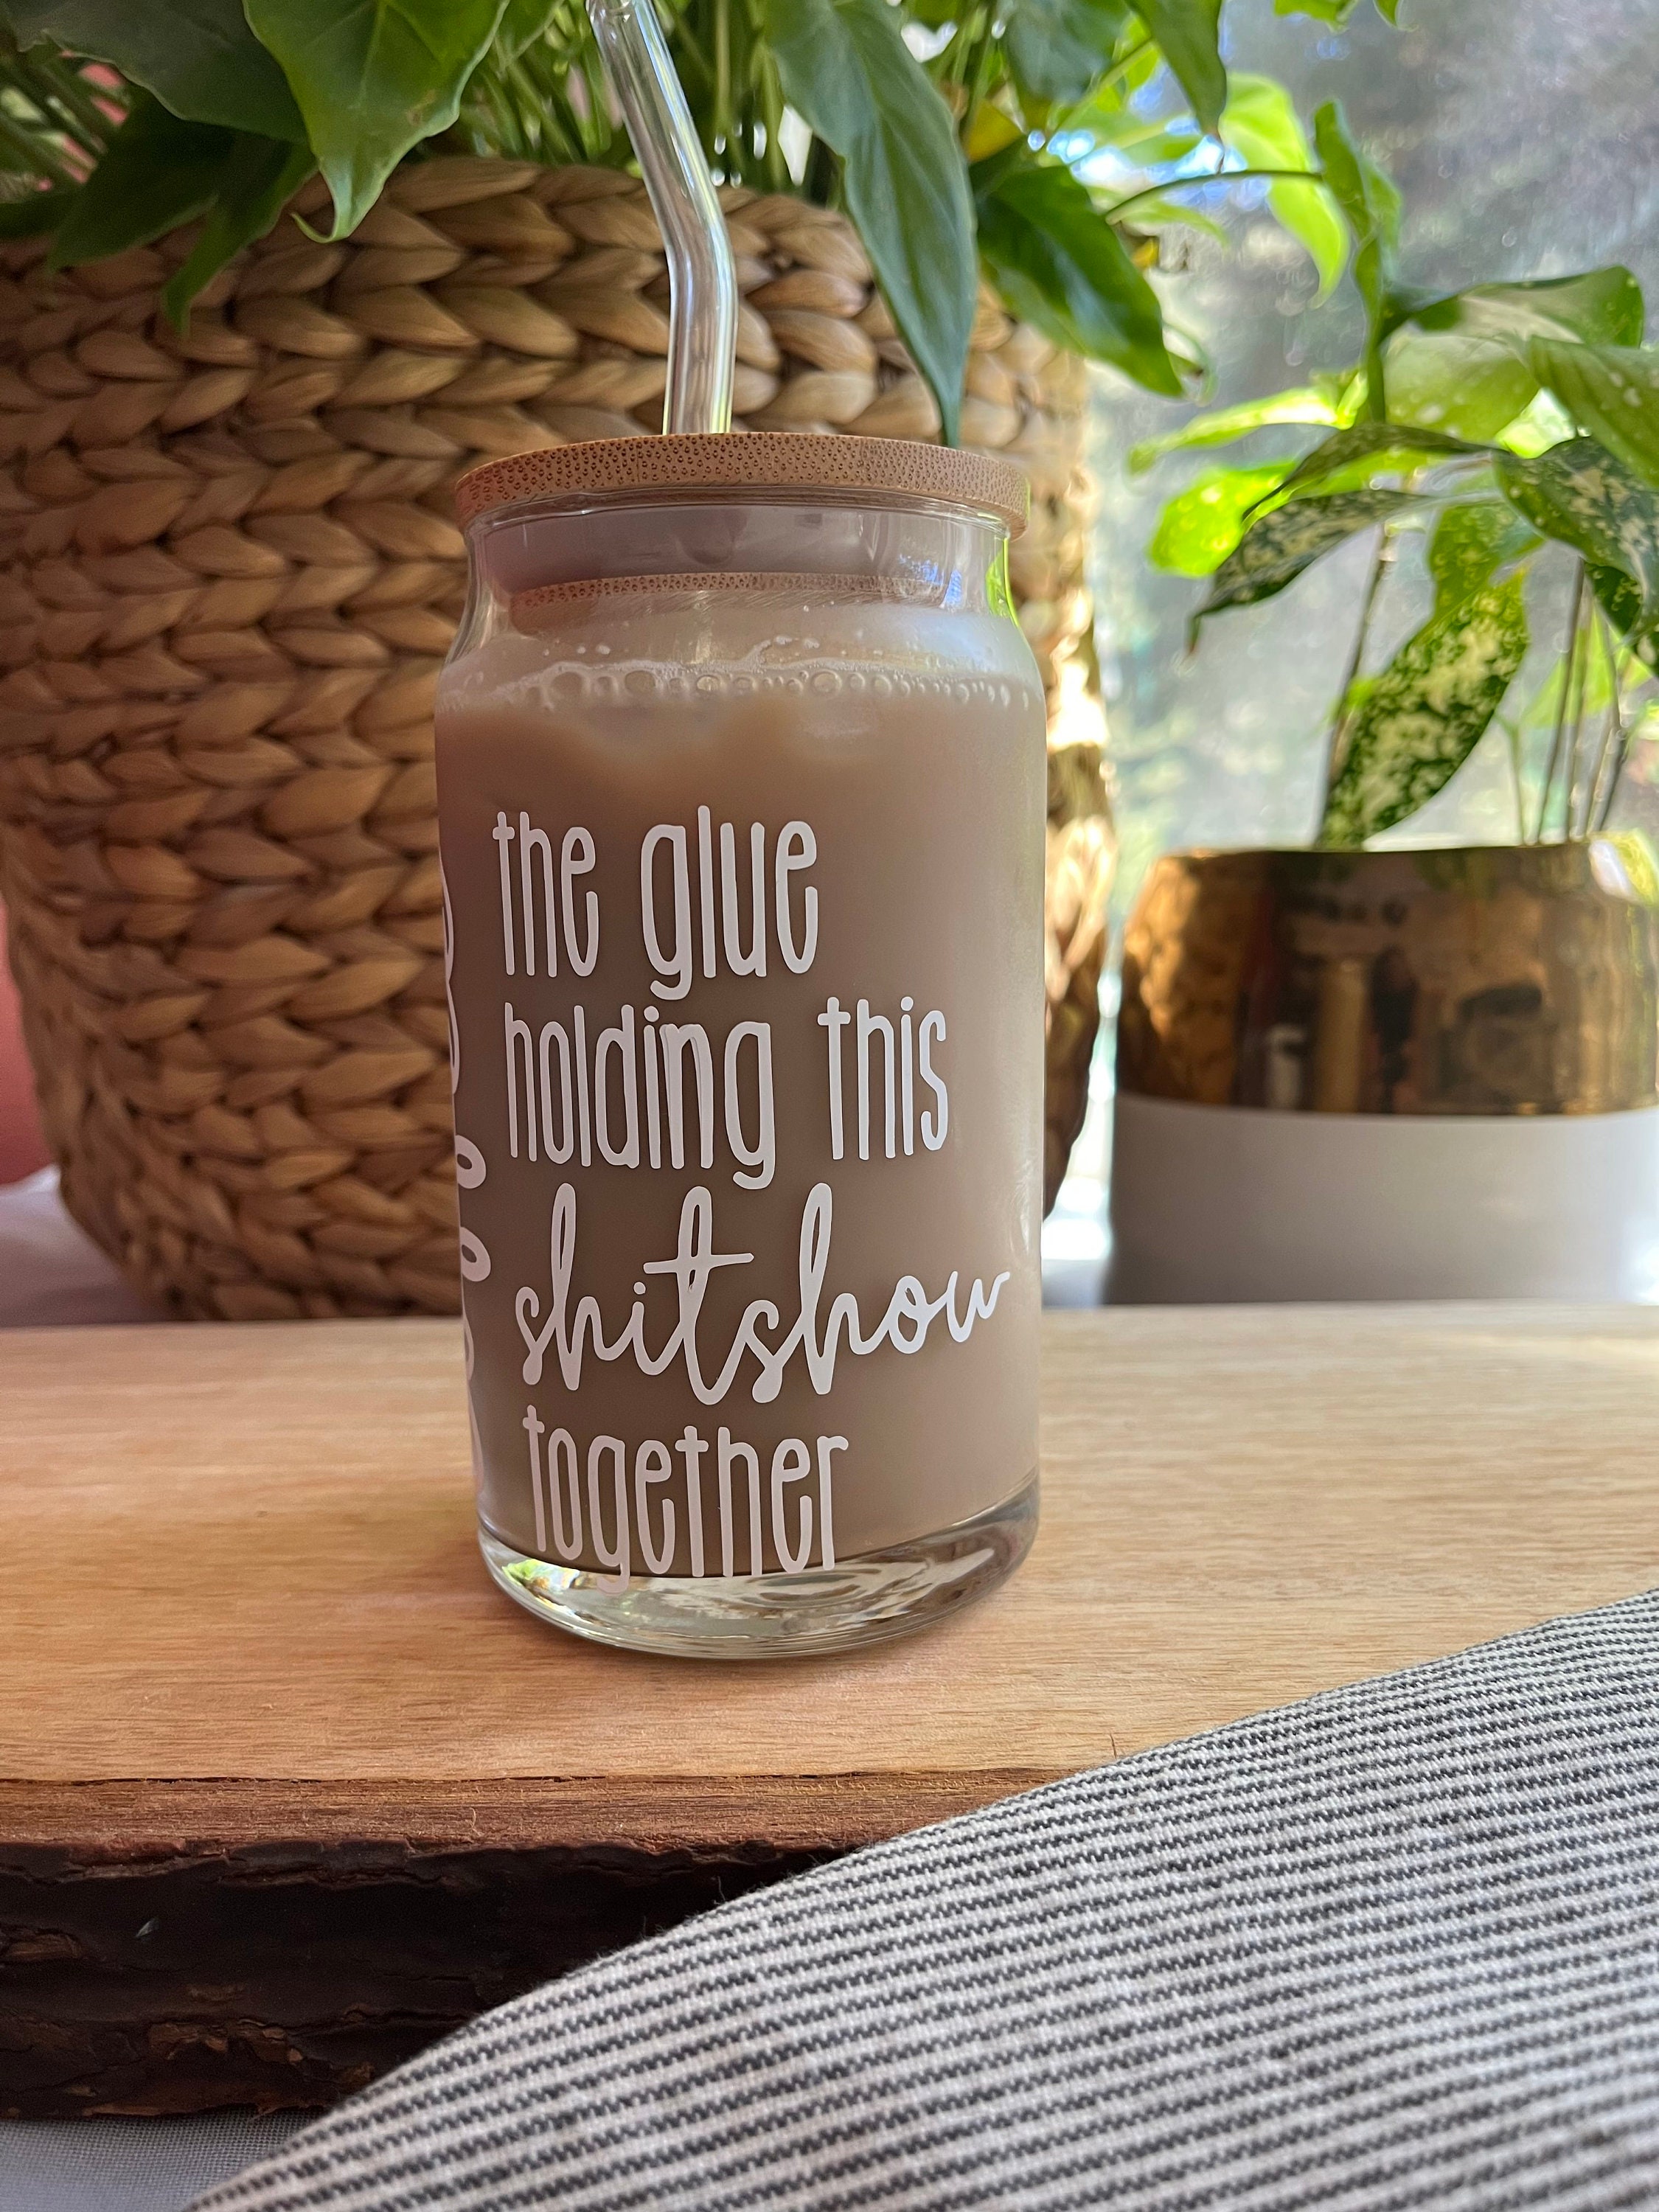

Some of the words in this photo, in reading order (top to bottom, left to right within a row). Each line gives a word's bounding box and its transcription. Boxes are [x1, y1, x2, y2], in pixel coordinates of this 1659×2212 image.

[492, 811, 599, 977] the
[641, 805, 818, 1000] glue
[504, 1002, 775, 1189] holding
[817, 996, 948, 1160] this
[515, 1183, 1011, 1405] shitshow
[522, 1405, 849, 1593] together
